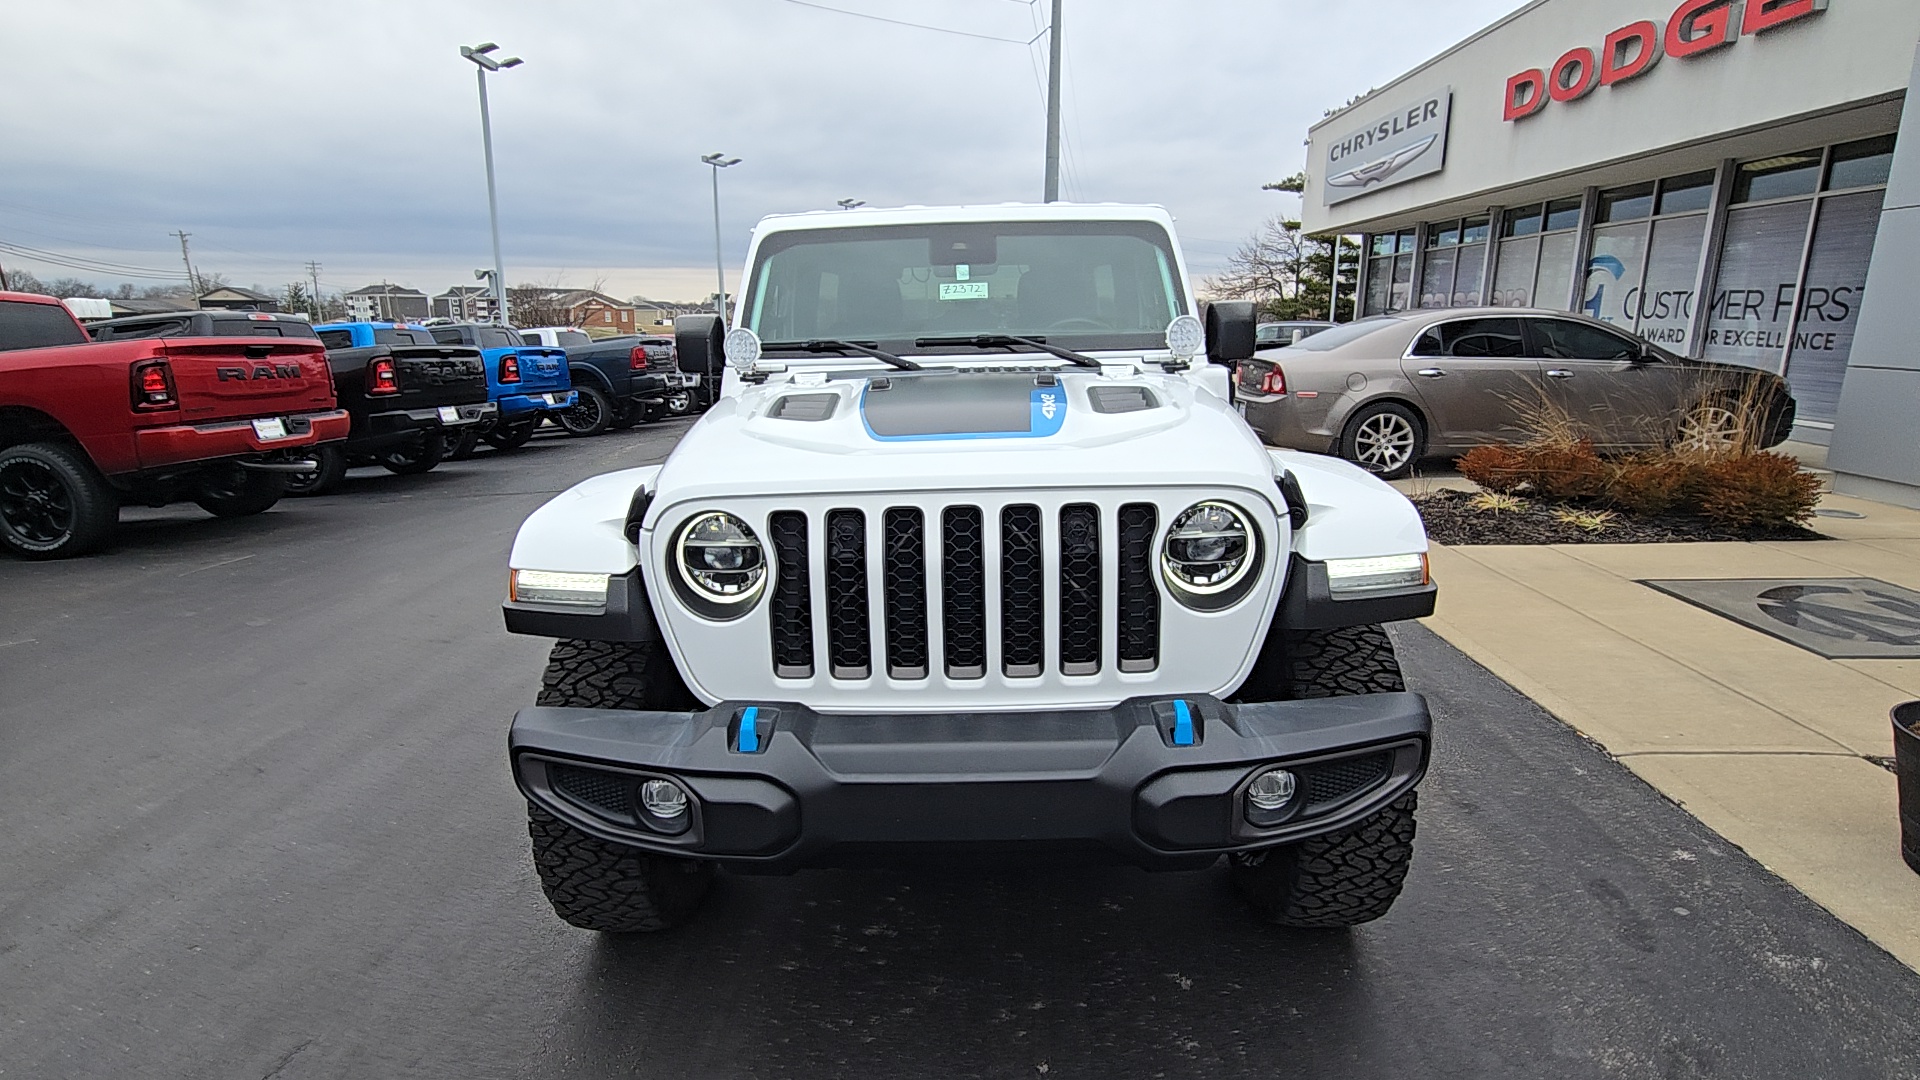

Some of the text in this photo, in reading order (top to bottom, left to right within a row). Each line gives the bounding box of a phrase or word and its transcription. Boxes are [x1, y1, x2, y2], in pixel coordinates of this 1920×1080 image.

[1330, 99, 1439, 162] CHRYSLER
[1772, 283, 1865, 323] FRS
[1723, 330, 1837, 350] EXCELLNCE
[216, 365, 302, 382] RAM
